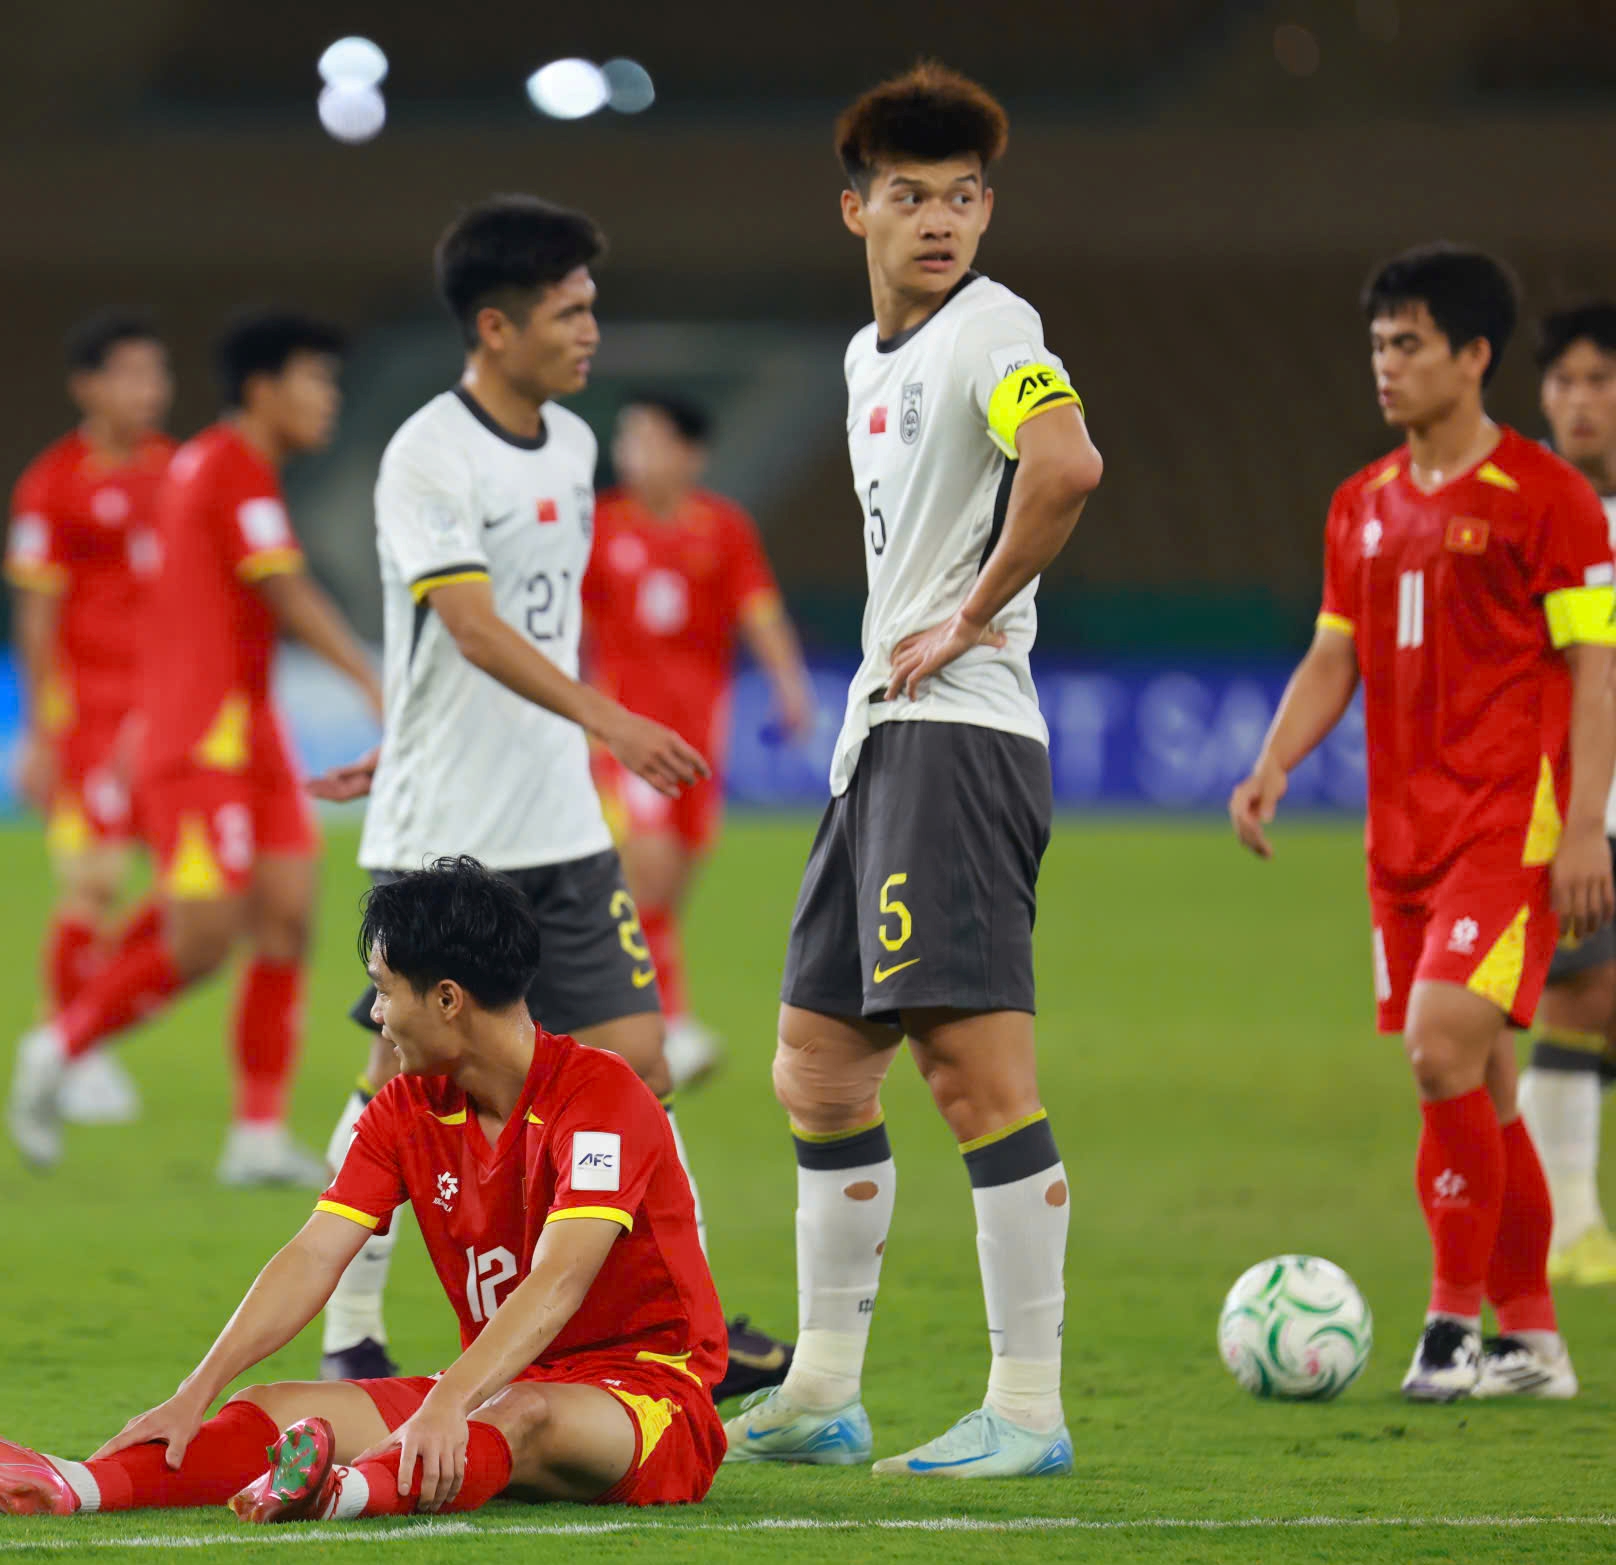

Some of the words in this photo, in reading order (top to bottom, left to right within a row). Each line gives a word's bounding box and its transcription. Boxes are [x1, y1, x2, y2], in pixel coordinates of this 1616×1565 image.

[869, 480, 886, 555] 5
[526, 570, 570, 639] 21
[1397, 569, 1424, 649] 11
[879, 872, 912, 951] 5
[578, 1153, 613, 1168] AFC
[465, 1246, 518, 1322] 12
